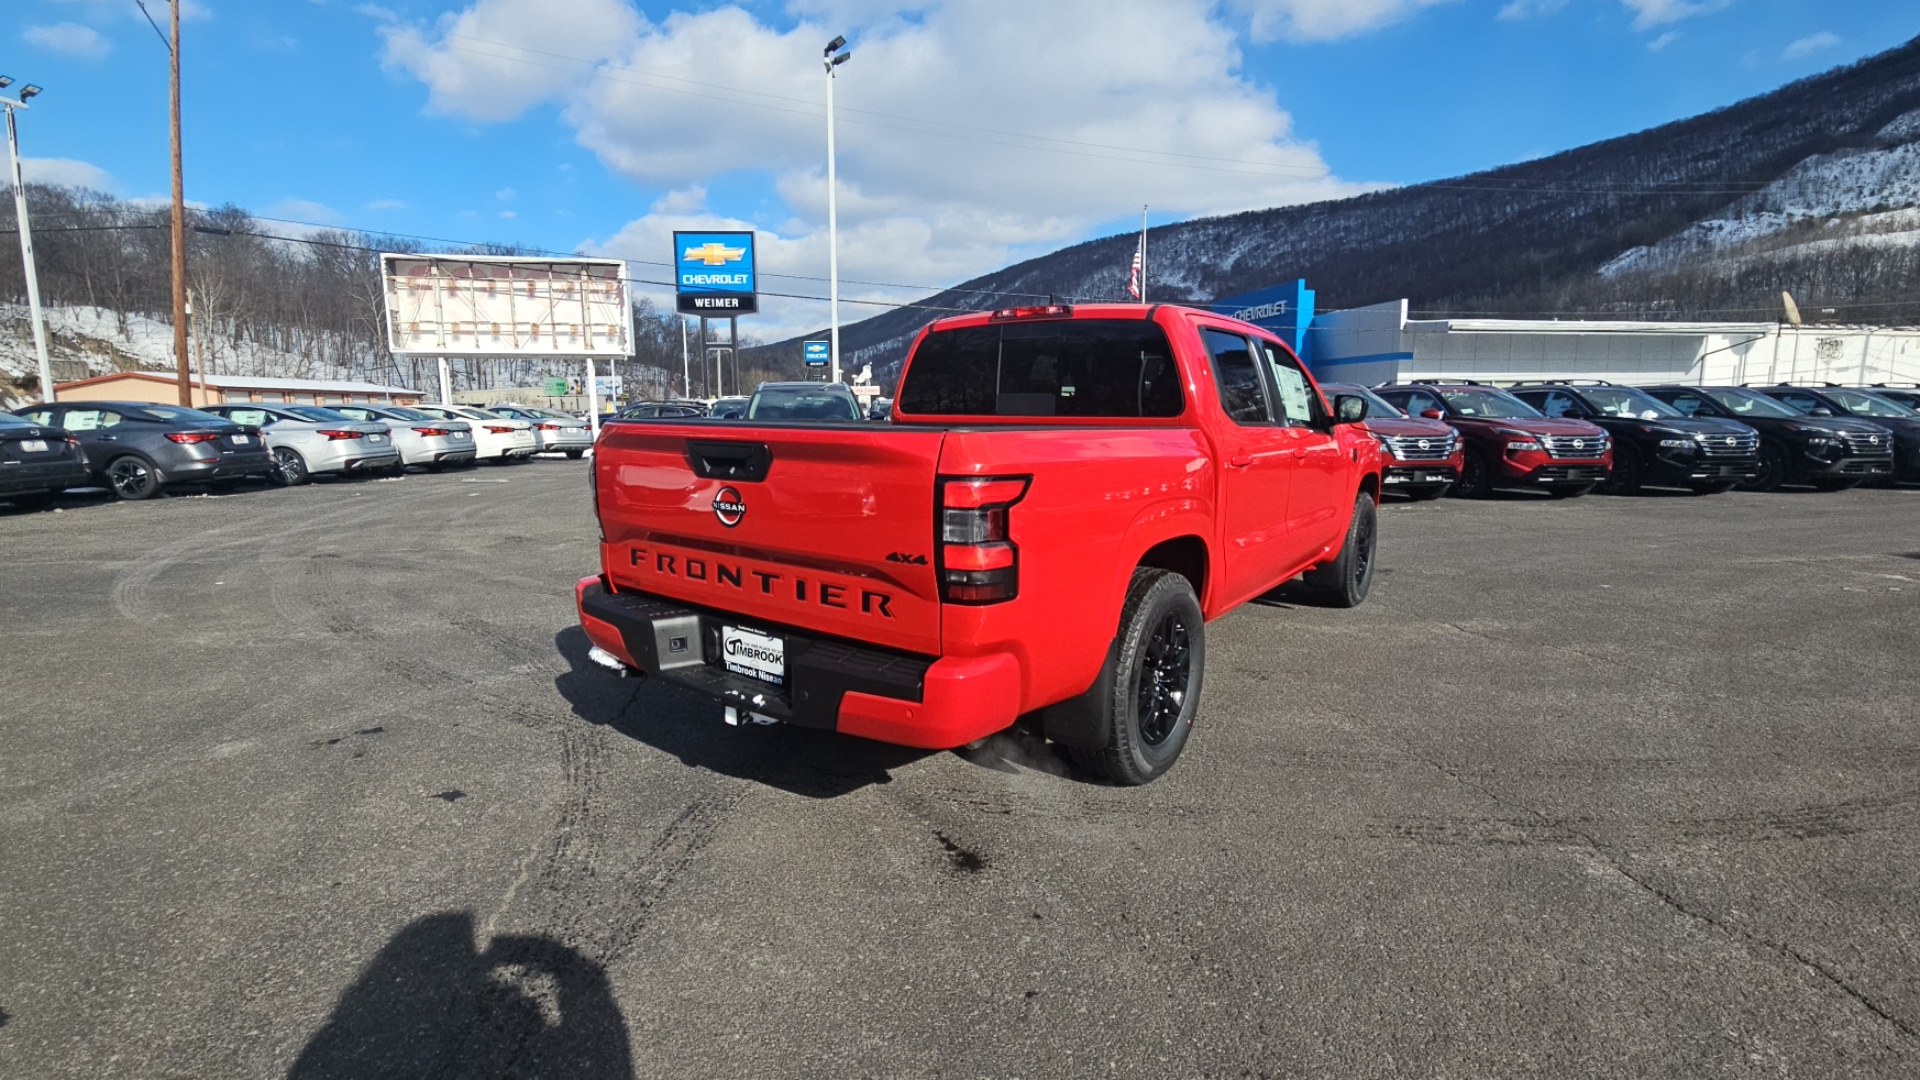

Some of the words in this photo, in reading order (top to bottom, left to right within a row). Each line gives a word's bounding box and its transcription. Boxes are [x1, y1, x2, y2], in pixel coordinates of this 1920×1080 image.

[682, 274, 749, 284] CHEVROLET
[694, 298, 739, 308] WEIMER
[1234, 299, 1288, 321] CHEVROLET
[713, 501, 746, 512] NISSAN
[629, 548, 893, 618] FRONTIER
[725, 636, 783, 666] TIMBROOK
[726, 662, 757, 678] Timbrook
[759, 671, 782, 685] Nissan
